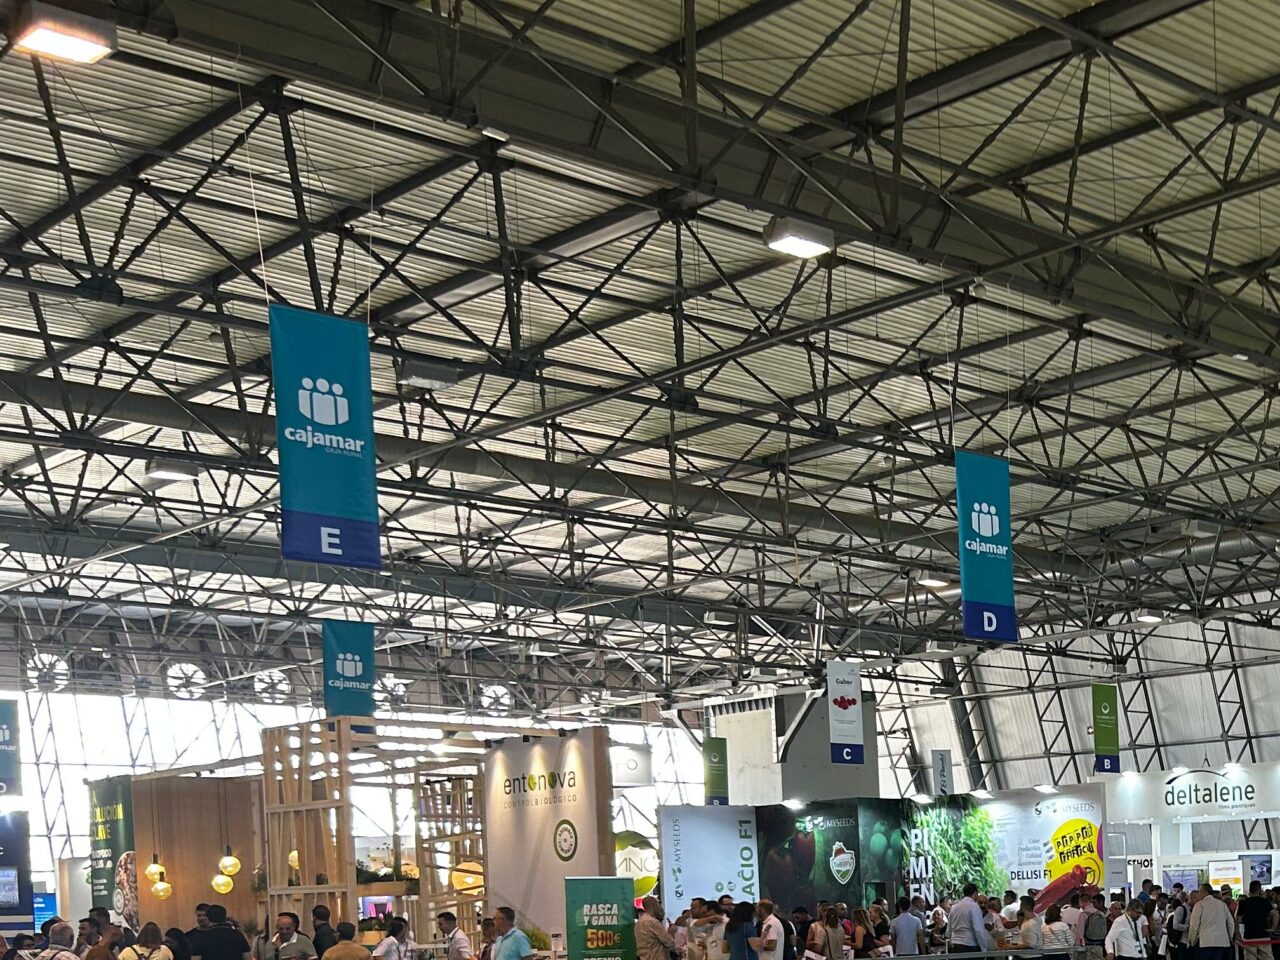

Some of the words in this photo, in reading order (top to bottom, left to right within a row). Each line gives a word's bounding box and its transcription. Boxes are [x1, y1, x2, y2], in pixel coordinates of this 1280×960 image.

[284, 425, 364, 452] cajamar
[320, 526, 342, 555] E
[965, 537, 1008, 556] cajamar
[983, 611, 997, 632] D
[328, 678, 371, 691] cajamar
[842, 747, 852, 761] C
[1103, 758, 1111, 770] B
[503, 770, 577, 796] entonova
[1164, 782, 1256, 806] deltalene
[738, 819, 752, 839] F1
[825, 817, 856, 829] MYSEEDS
[910, 828, 930, 853] PI
[910, 855, 933, 879] MI
[1010, 869, 1042, 881] DELLISI
[583, 903, 619, 917] RASCA
[583, 915, 591, 926] Y
[591, 914, 619, 926] GANA
